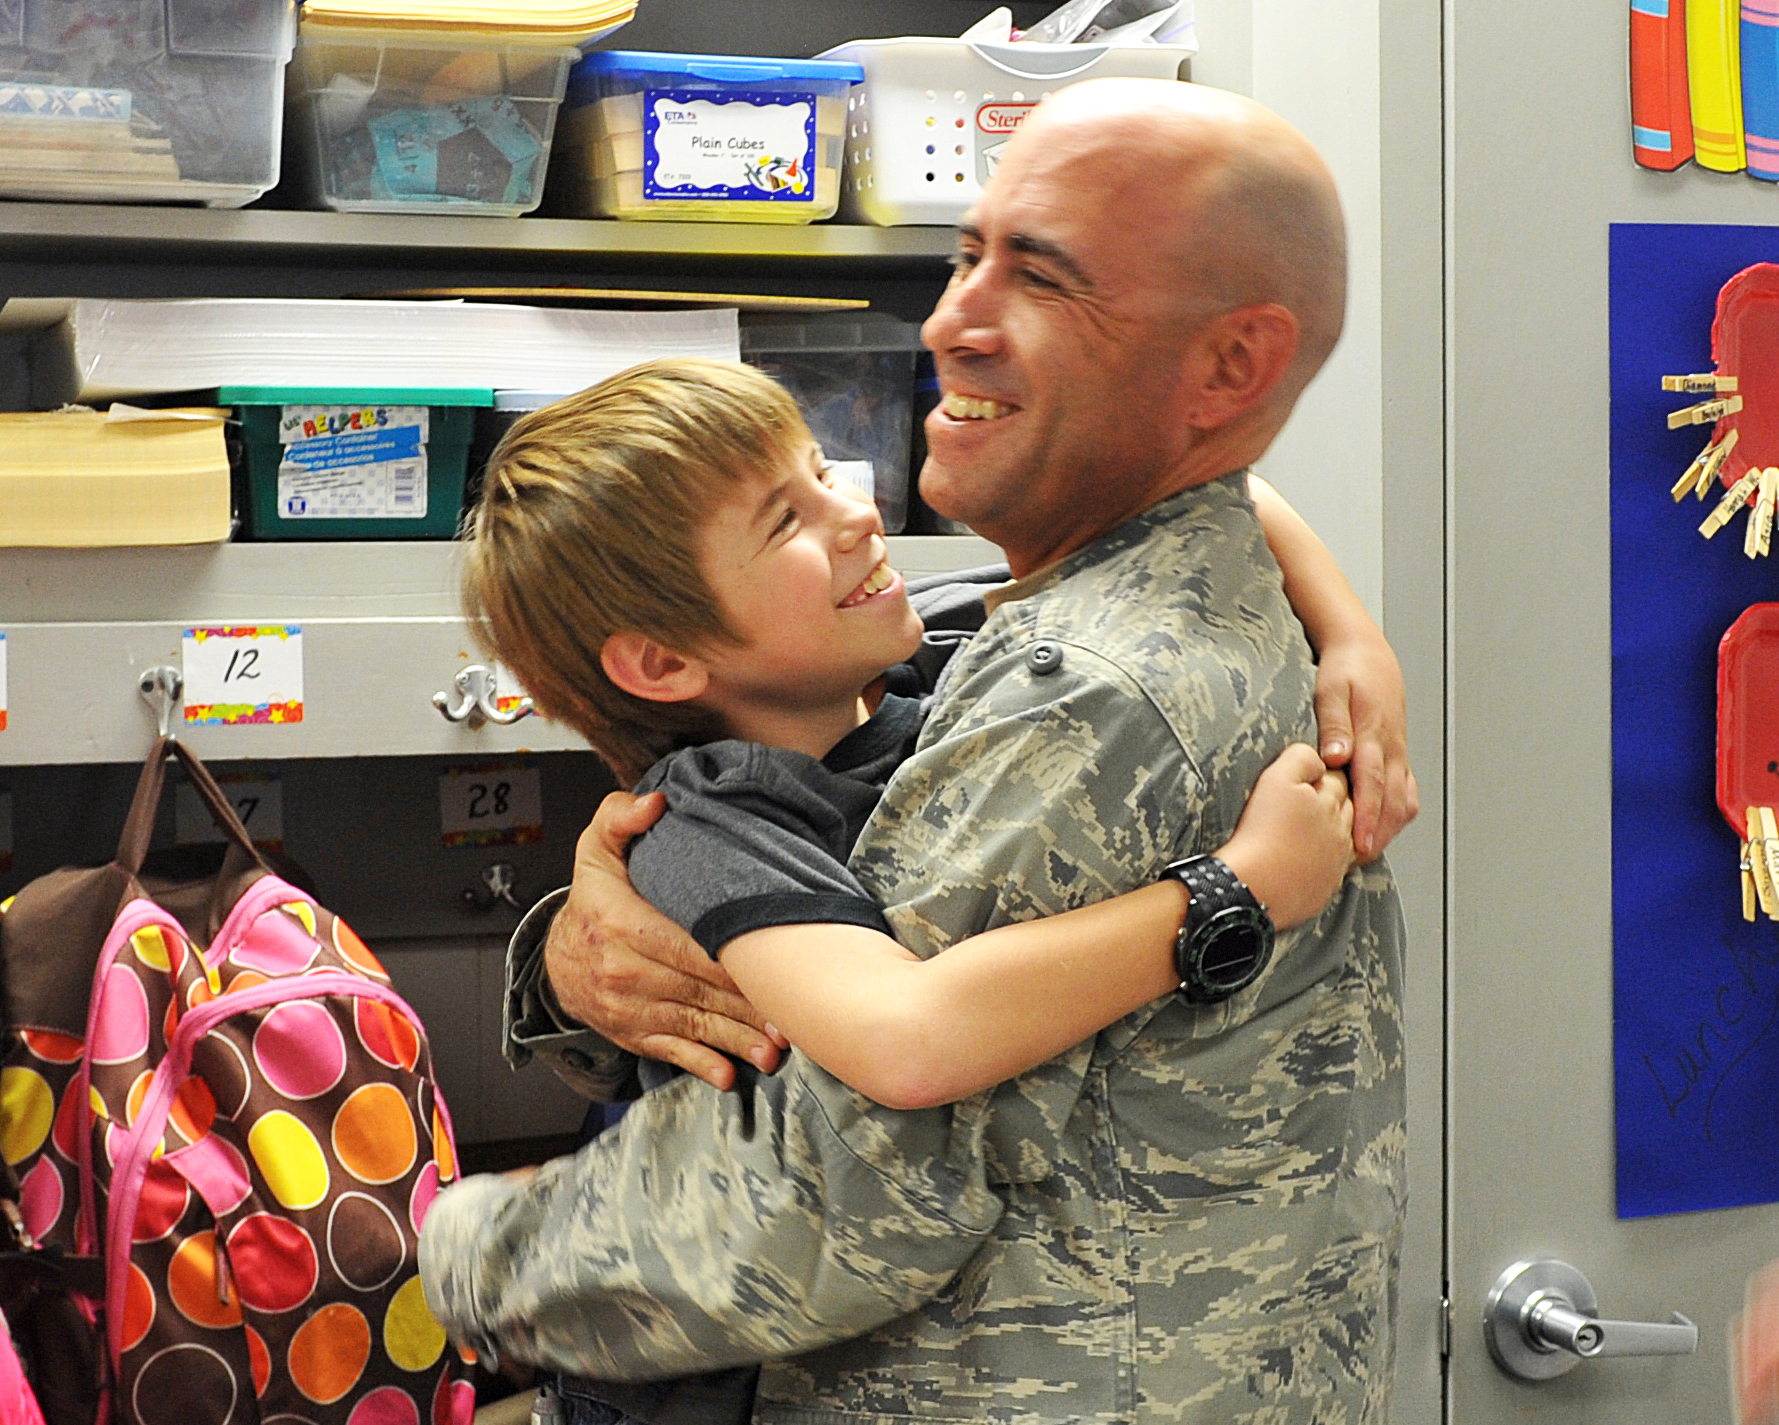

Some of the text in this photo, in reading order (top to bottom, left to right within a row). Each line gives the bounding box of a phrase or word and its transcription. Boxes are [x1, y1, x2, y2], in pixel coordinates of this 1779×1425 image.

[664, 111, 684, 120] ETA
[691, 136, 765, 150] Plain Cubes
[303, 408, 388, 438] HELPERS
[223, 648, 261, 683] 12
[468, 782, 511, 819] 28
[1643, 934, 1779, 1118] Lunch
